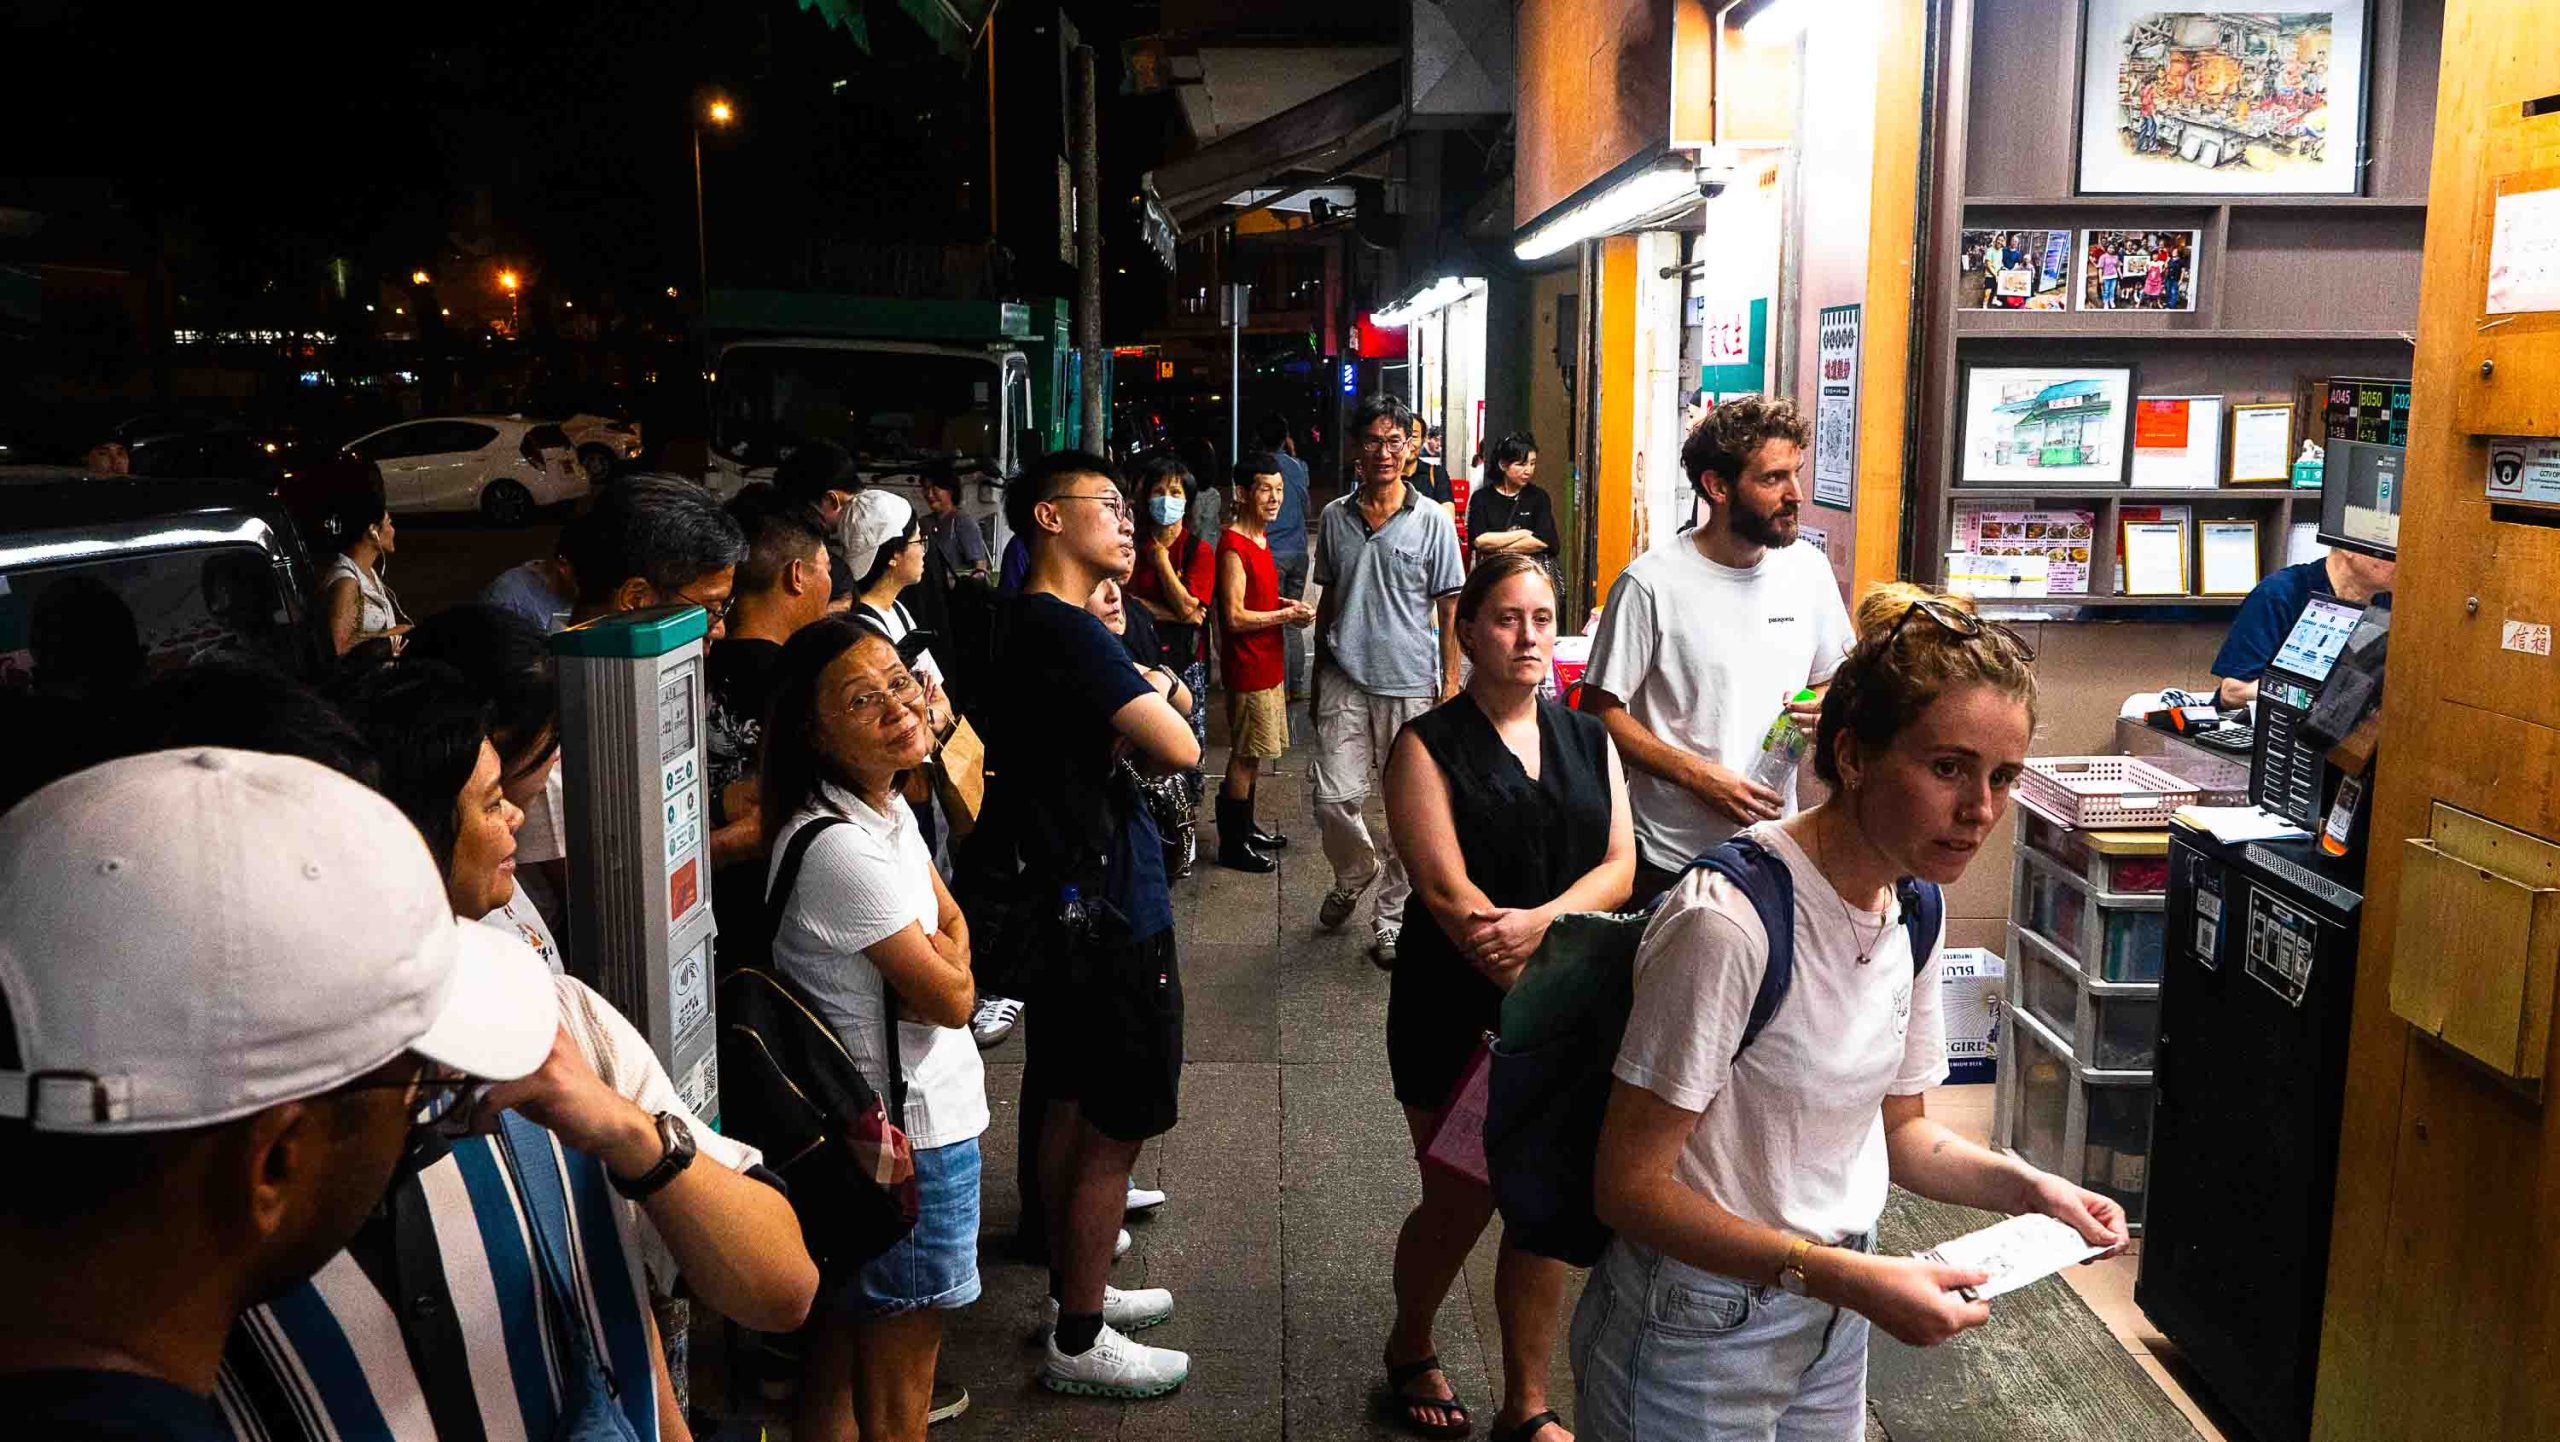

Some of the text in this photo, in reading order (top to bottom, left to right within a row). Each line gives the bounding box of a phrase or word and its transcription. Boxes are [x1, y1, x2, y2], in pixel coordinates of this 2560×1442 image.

[2330, 389, 2410, 409] A045 B050 C02
[2507, 624, 2547, 655] 信箱
[1951, 1042, 1983, 1052] GIRL
